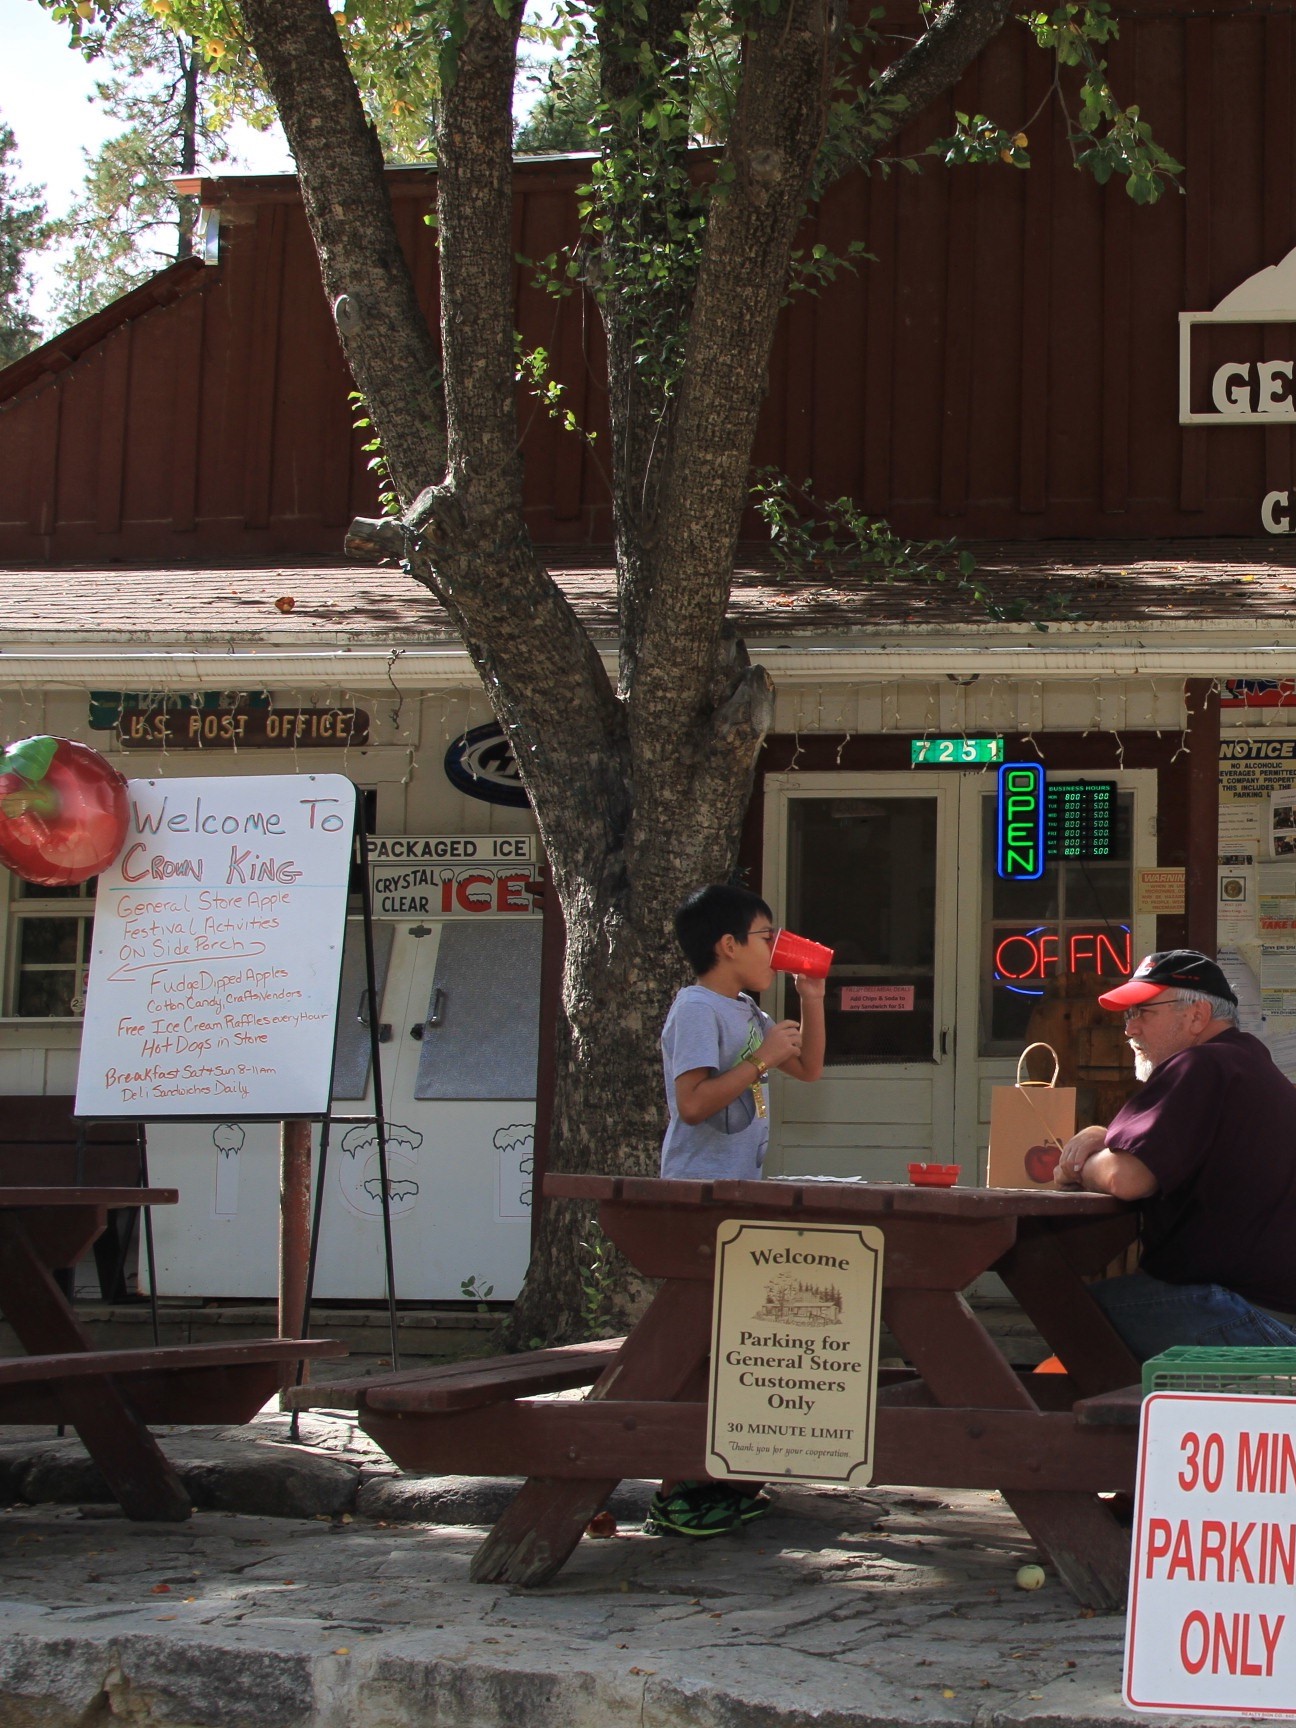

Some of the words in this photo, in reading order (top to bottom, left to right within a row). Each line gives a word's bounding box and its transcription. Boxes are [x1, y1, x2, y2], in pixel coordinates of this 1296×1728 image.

[189, 715, 248, 739] POST
[267, 714, 350, 738] OFFICE
[915, 740, 999, 761] 7251
[1219, 742, 1296, 758] NOTICE
[1244, 762, 1283, 770] ALCOHOLIC
[132, 796, 286, 836] Welcome
[299, 798, 344, 832] To
[1008, 771, 1034, 873] OPEN
[368, 840, 478, 859] PACKAGED
[493, 840, 527, 857] ICE
[375, 868, 439, 893] CRYSTAL
[1144, 873, 1186, 882] WARNIN
[382, 895, 429, 914] CLEAR
[439, 867, 531, 914] ICE
[117, 894, 190, 919] General
[198, 890, 242, 911] Store
[247, 890, 290, 911] Apple
[123, 918, 197, 941] Festival
[204, 916, 280, 936] Activities
[1261, 919, 1288, 930] TAKE
[152, 938, 191, 957] Side
[194, 935, 245, 953] Porch
[151, 968, 199, 995] Fudge
[200, 970, 242, 994] Dipped
[246, 966, 289, 989] Apples
[147, 1000, 185, 1014] Cotton
[259, 988, 302, 1002] Vendors
[117, 1016, 146, 1037] Free
[151, 1019, 180, 1036] Ice
[184, 1015, 223, 1034] Cream
[224, 1014, 271, 1030] Raffles
[272, 1014, 300, 1028] every
[299, 1012, 329, 1022] Hour
[141, 1036, 173, 1058] Hot
[176, 1035, 213, 1058] Dogs
[217, 1035, 230, 1049] in
[233, 1032, 268, 1048] Store
[105, 1064, 180, 1089] Breakfast
[214, 1063, 236, 1077] Sun
[121, 1085, 149, 1102] Deli
[151, 1083, 211, 1099] Sandwiches
[214, 1079, 250, 1099] Daily
[749, 1248, 850, 1270] Welcome
[740, 1331, 815, 1354] Parking
[822, 1335, 850, 1351] for
[726, 1351, 803, 1369] General
[810, 1355, 862, 1372] Store
[739, 1372, 846, 1392] Customers
[768, 1394, 815, 1415] Only
[727, 1422, 743, 1433] 30
[748, 1423, 807, 1437] MINUTE
[811, 1427, 854, 1440] LIMIT
[729, 1441, 754, 1452] Thank
[756, 1444, 770, 1455] you
[772, 1443, 784, 1455] for
[785, 1446, 803, 1457] your
[1178, 1432, 1225, 1493] 30
[1180, 1609, 1286, 1677] ONLY
